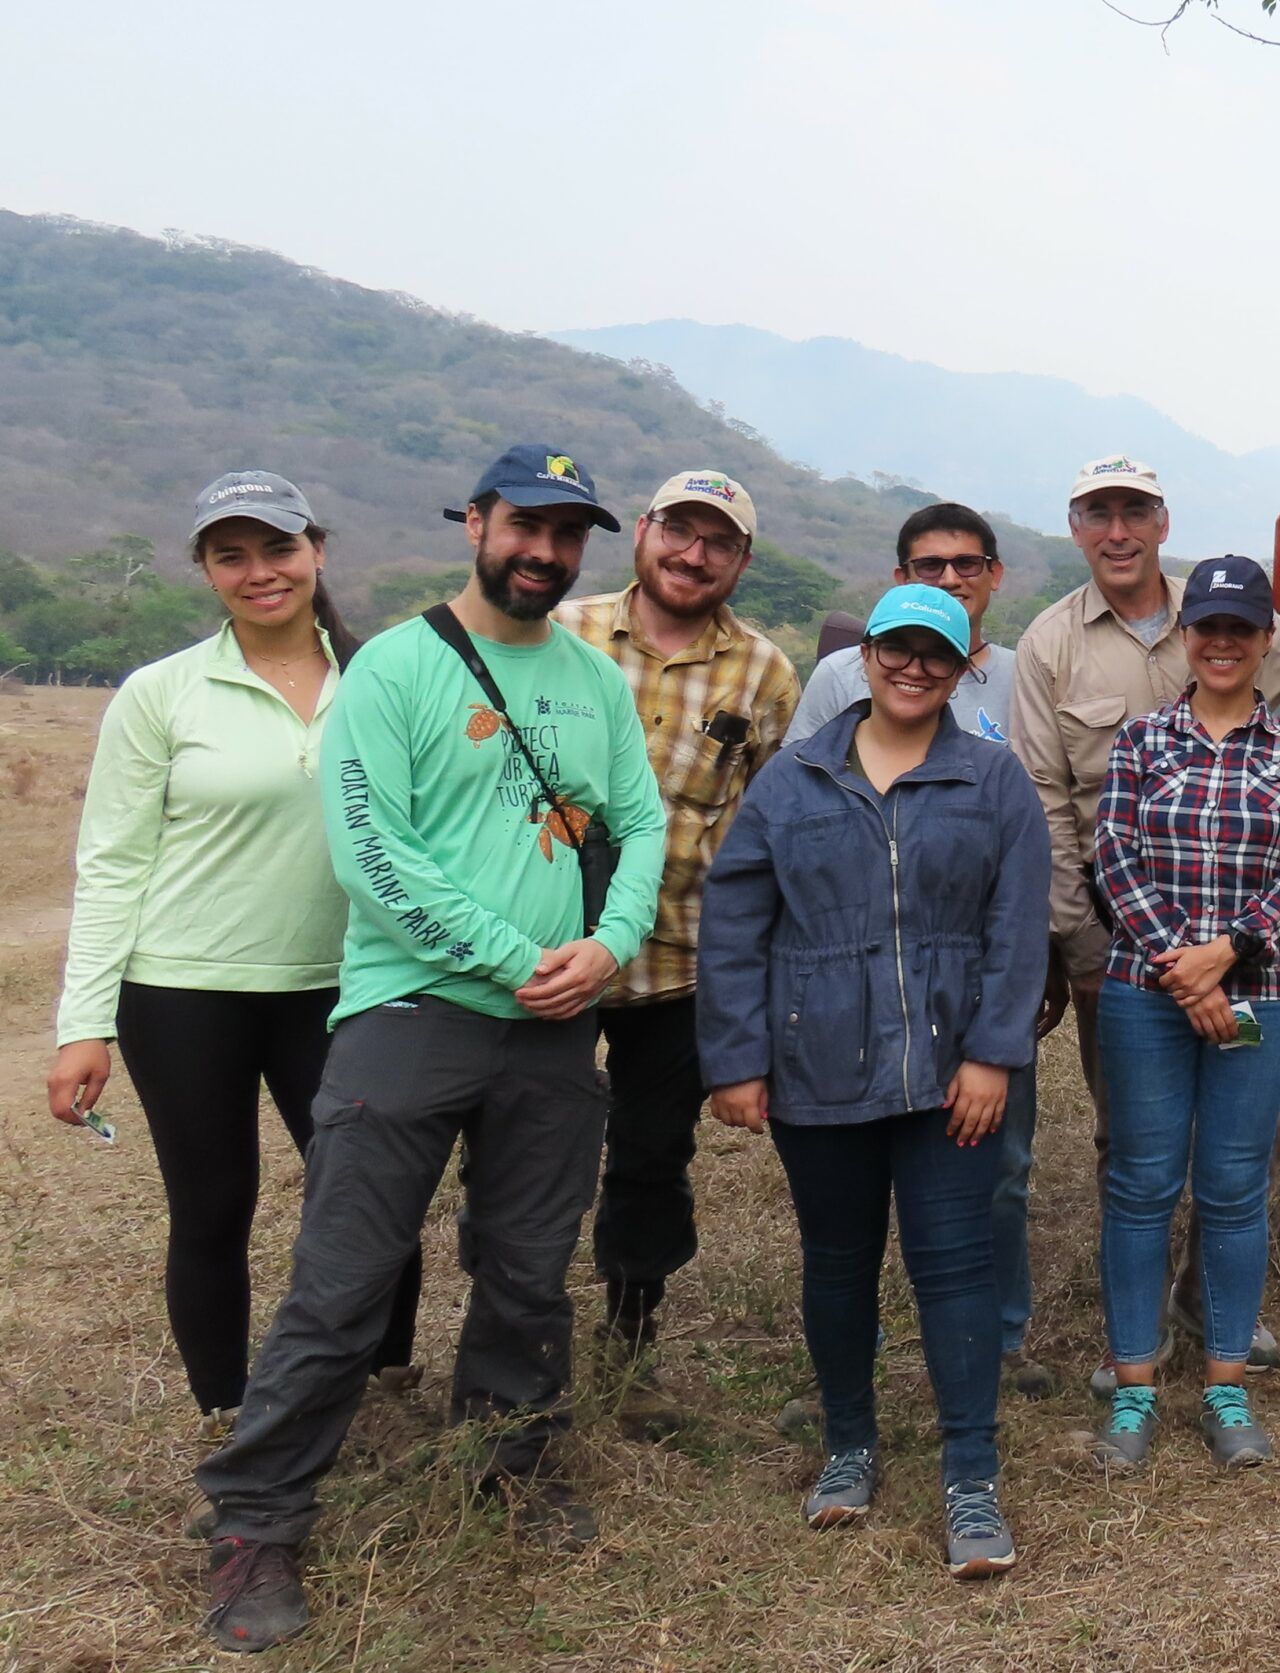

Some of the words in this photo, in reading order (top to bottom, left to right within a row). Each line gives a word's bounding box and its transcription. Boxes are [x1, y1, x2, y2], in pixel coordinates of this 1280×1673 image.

[208, 483, 274, 504] Chingona
[910, 601, 951, 621] Columbia
[352, 835, 411, 908] MARINE
[395, 906, 452, 951] PARK
